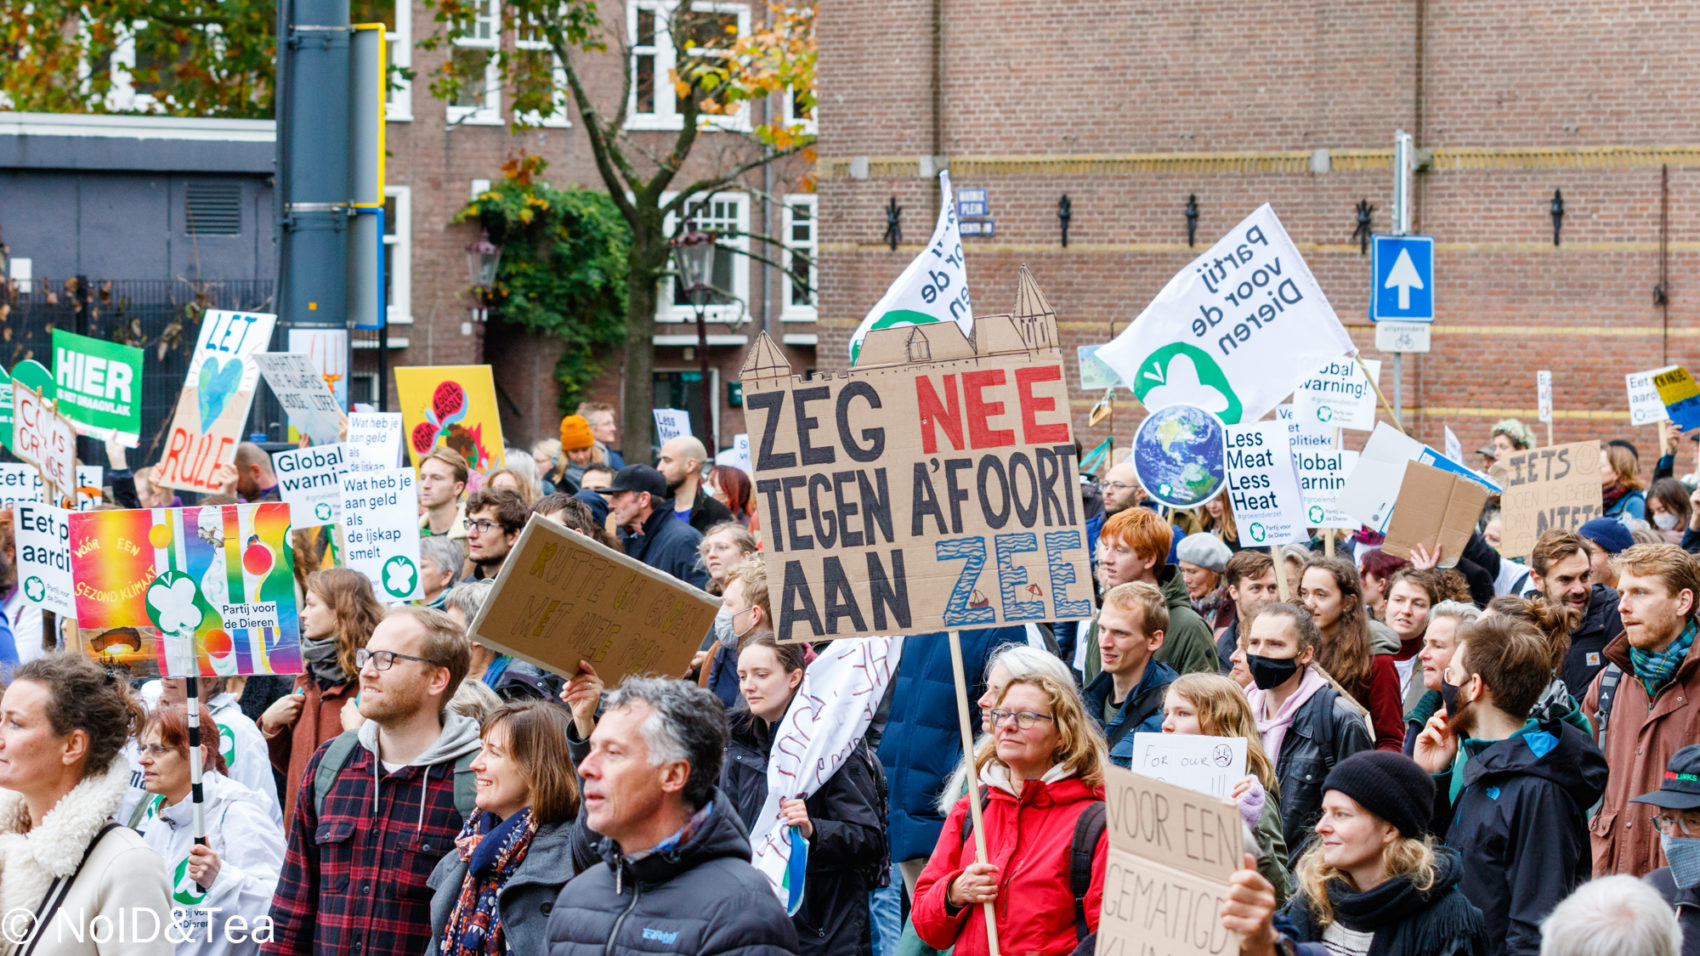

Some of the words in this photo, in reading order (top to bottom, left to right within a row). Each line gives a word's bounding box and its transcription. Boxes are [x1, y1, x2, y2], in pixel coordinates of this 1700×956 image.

[205, 313, 258, 355] LET
[57, 347, 133, 403] HIER
[657, 413, 676, 427] Less
[747, 381, 886, 471] ZEG
[915, 365, 1070, 454] NEE
[1225, 430, 1264, 448] Less
[162, 427, 234, 491] RULE
[279, 446, 344, 472] Global
[1227, 449, 1274, 469] Meat
[1297, 453, 1342, 470] lobal
[1510, 448, 1571, 487] IETS
[282, 465, 350, 492] warni
[344, 481, 368, 492] Wat
[371, 476, 396, 488] heb
[399, 475, 412, 491] je
[1228, 472, 1271, 490] Less
[1302, 473, 1346, 490] arnin
[345, 498, 366, 509] aan
[369, 492, 397, 510] geld
[756, 468, 894, 552] TEGEN
[1232, 491, 1278, 511] Heat
[20, 507, 55, 535] Eet
[346, 513, 363, 526] als
[348, 531, 363, 543] de
[366, 527, 401, 545] ijskap
[117, 537, 140, 557] EEN
[350, 546, 381, 560] smelt
[22, 545, 70, 573] aardi
[778, 548, 912, 641] AAN
[936, 530, 1091, 627] ZEE
[223, 604, 250, 615] Partij
[252, 604, 276, 613] voor
[224, 618, 238, 629] de
[239, 617, 274, 628] Dieren
[1105, 785, 1172, 851] VOOR
[1184, 803, 1239, 871] EEN
[1103, 863, 1229, 956] GEMATIGD
